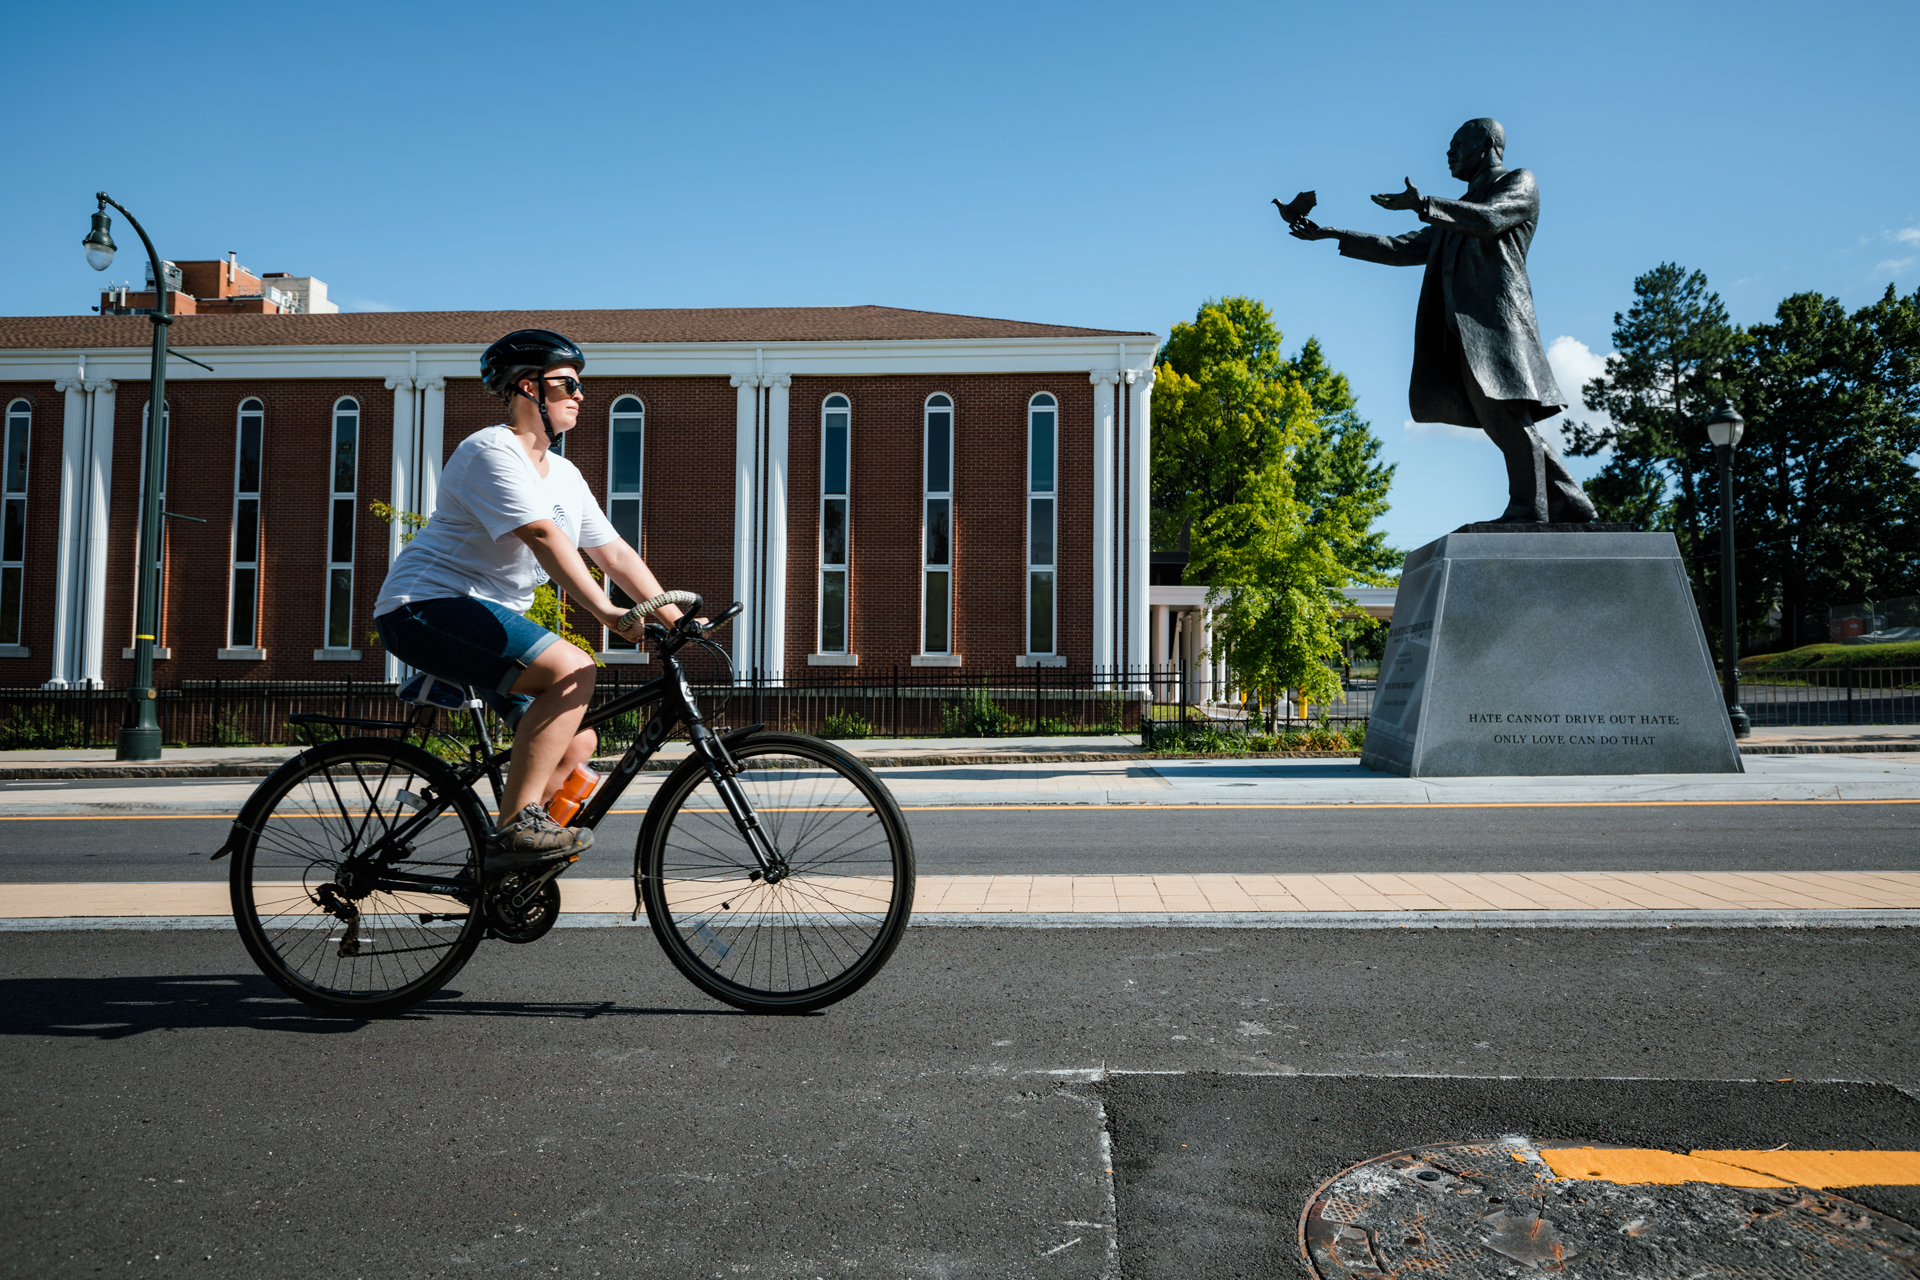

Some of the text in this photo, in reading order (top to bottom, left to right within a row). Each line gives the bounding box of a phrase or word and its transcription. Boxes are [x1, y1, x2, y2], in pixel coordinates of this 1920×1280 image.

[1469, 713, 1680, 725] HATE CANNOT DRIVE OUT HATE;
[1494, 734, 1656, 745] ONLY LOVE CAN DO THAT
[430, 885, 460, 895] evo
